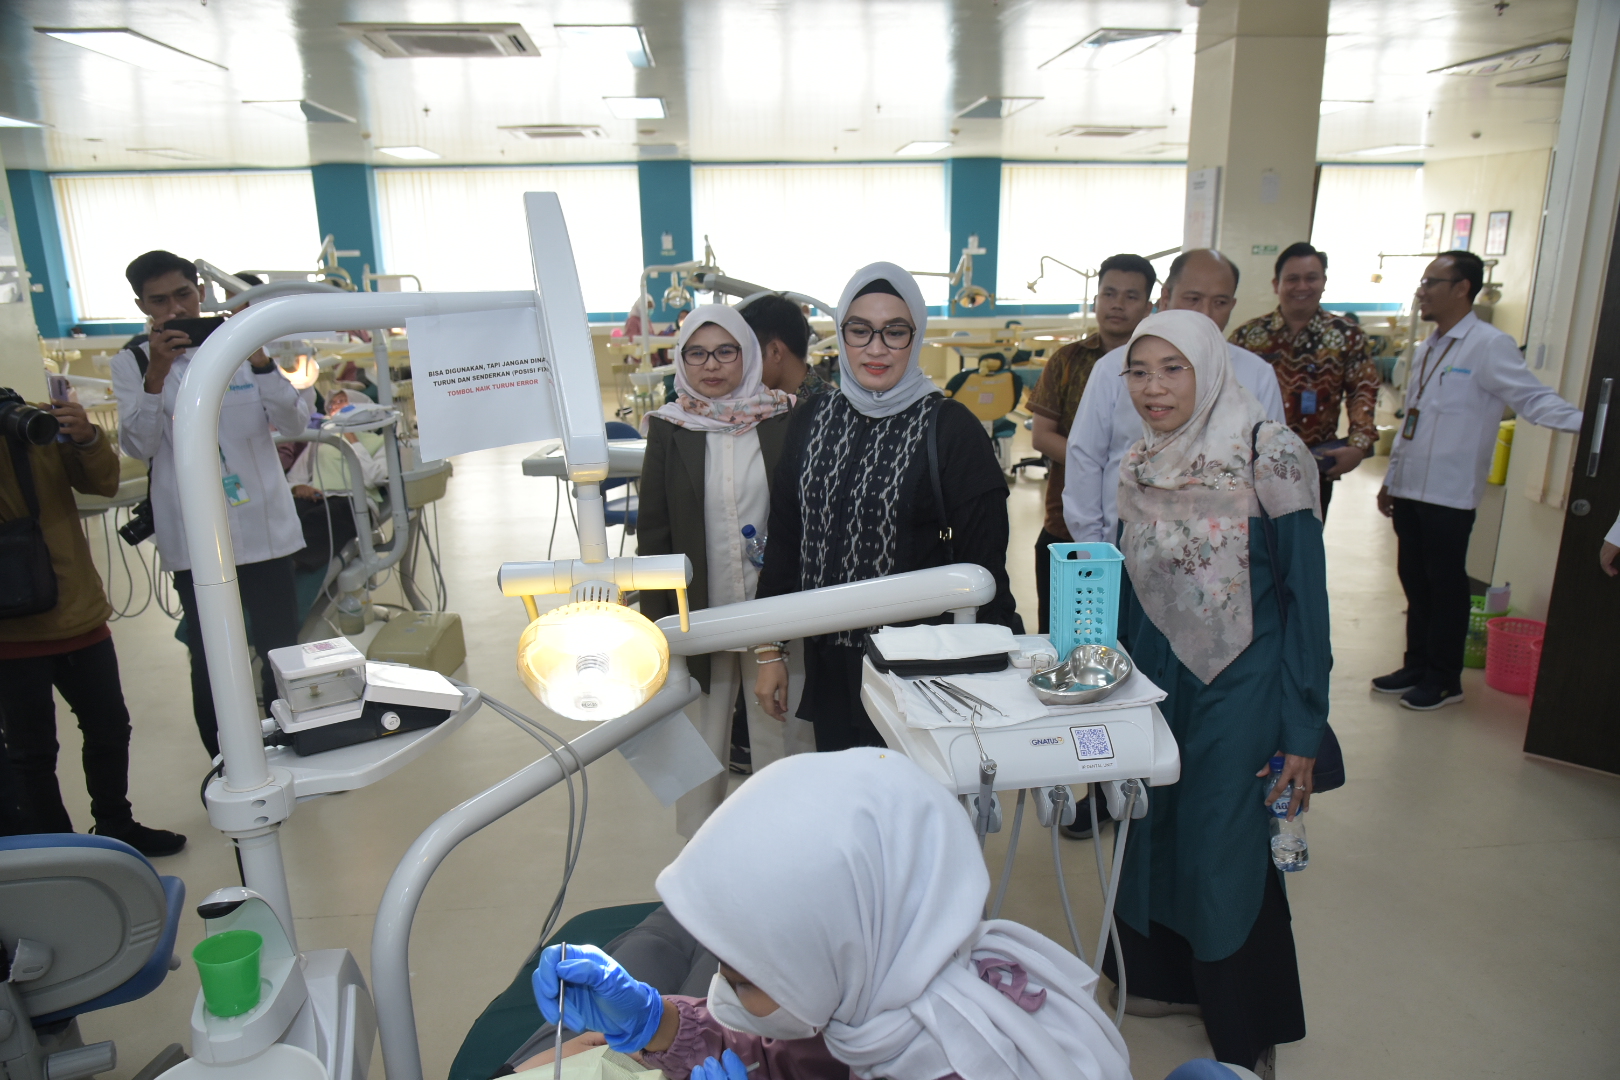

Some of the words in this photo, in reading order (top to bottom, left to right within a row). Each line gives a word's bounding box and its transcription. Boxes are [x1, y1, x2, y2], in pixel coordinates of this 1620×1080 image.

[428, 370, 444, 378] BISA
[445, 364, 486, 375] DIGUNAKAN,
[502, 359, 529, 367] JANGAN
[433, 379, 456, 387] TURUN
[472, 371, 511, 381] SENDERKAN
[512, 368, 536, 377] (POSISI
[447, 388, 474, 397] TOMBOL
[475, 385, 491, 393] NAIK
[492, 382, 515, 390] TURUN
[516, 379, 539, 387] ERROR
[1031, 738, 1059, 746] GNATUS
